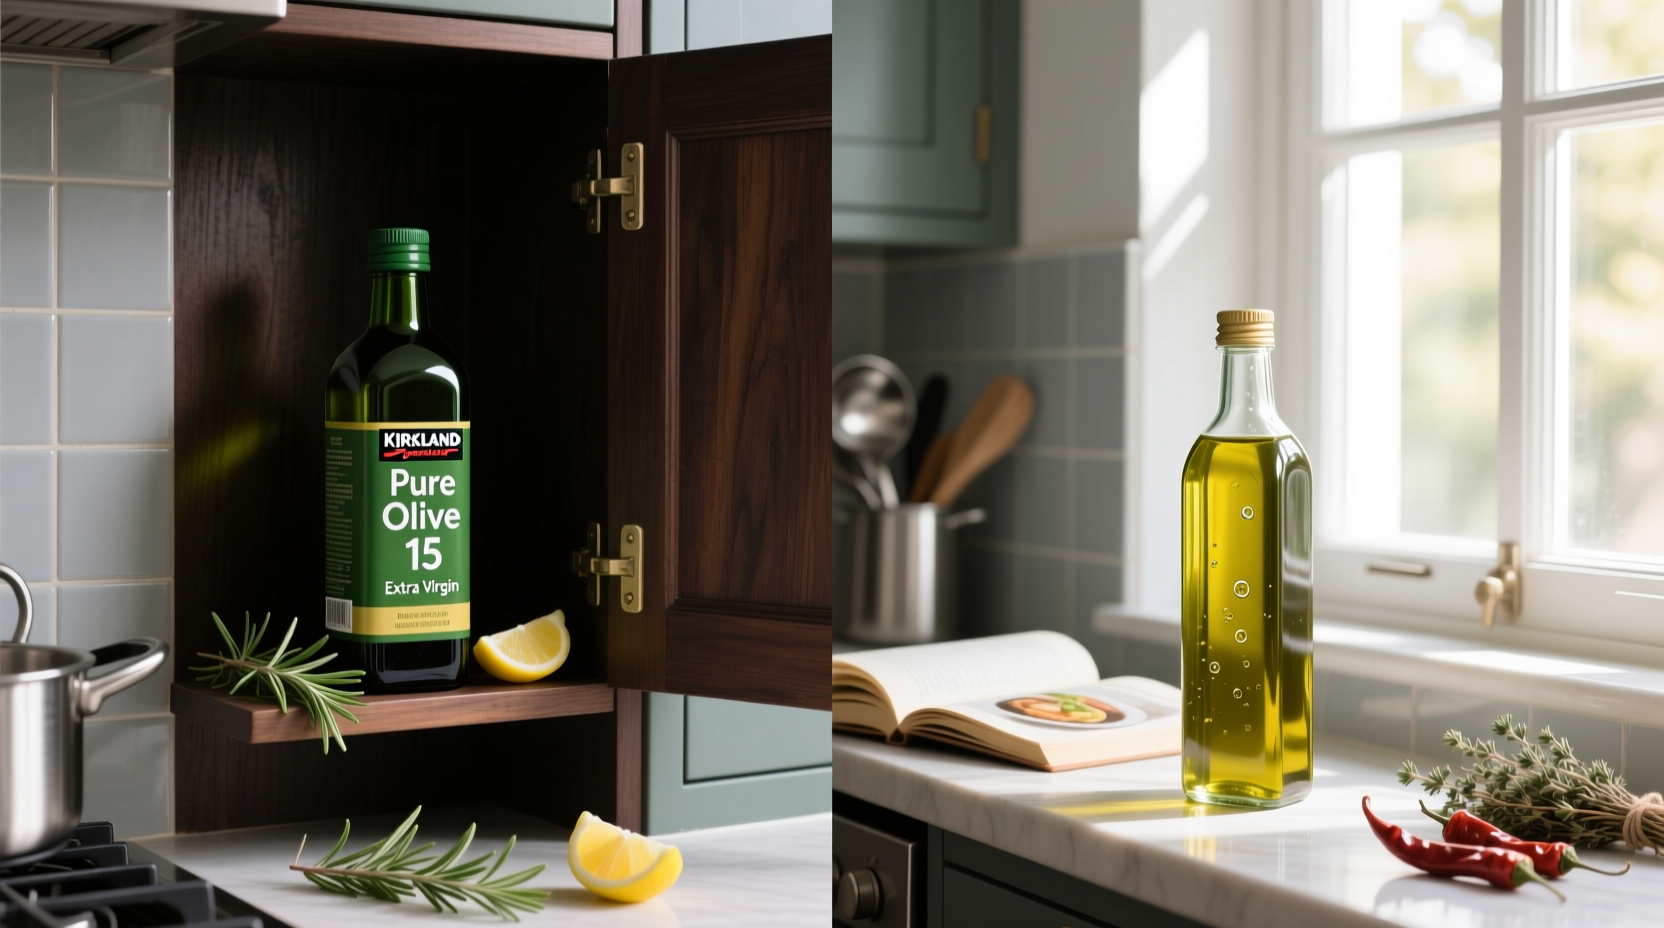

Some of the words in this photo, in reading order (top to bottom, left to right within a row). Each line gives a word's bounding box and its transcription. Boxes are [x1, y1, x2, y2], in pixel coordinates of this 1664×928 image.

[384, 432, 462, 448] KIRKLAND
[390, 468, 456, 497] Pure
[382, 501, 461, 531] Olive
[405, 536, 443, 571] 15
[385, 581, 420, 596] Extra
